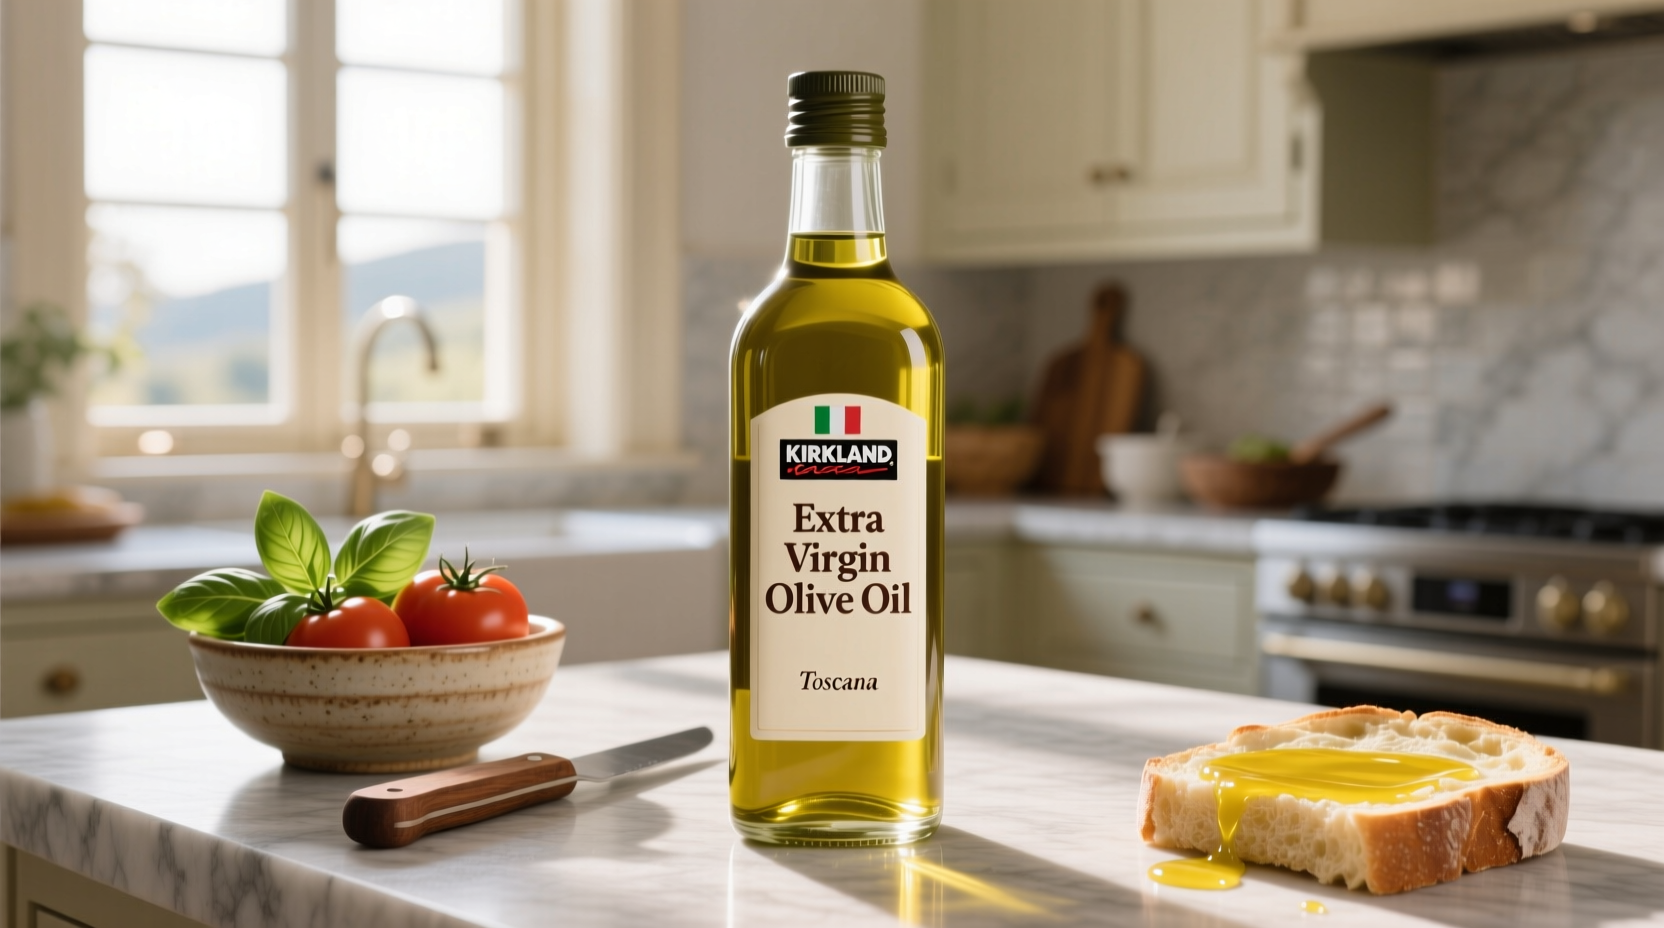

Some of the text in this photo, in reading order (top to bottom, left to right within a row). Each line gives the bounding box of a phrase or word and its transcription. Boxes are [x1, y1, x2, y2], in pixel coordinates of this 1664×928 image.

[786, 444, 893, 464] KIRKLAND
[792, 503, 885, 534] Extra
[784, 542, 892, 583] Virgin
[765, 582, 912, 615] Olive Oil
[799, 670, 879, 691] Toscana
